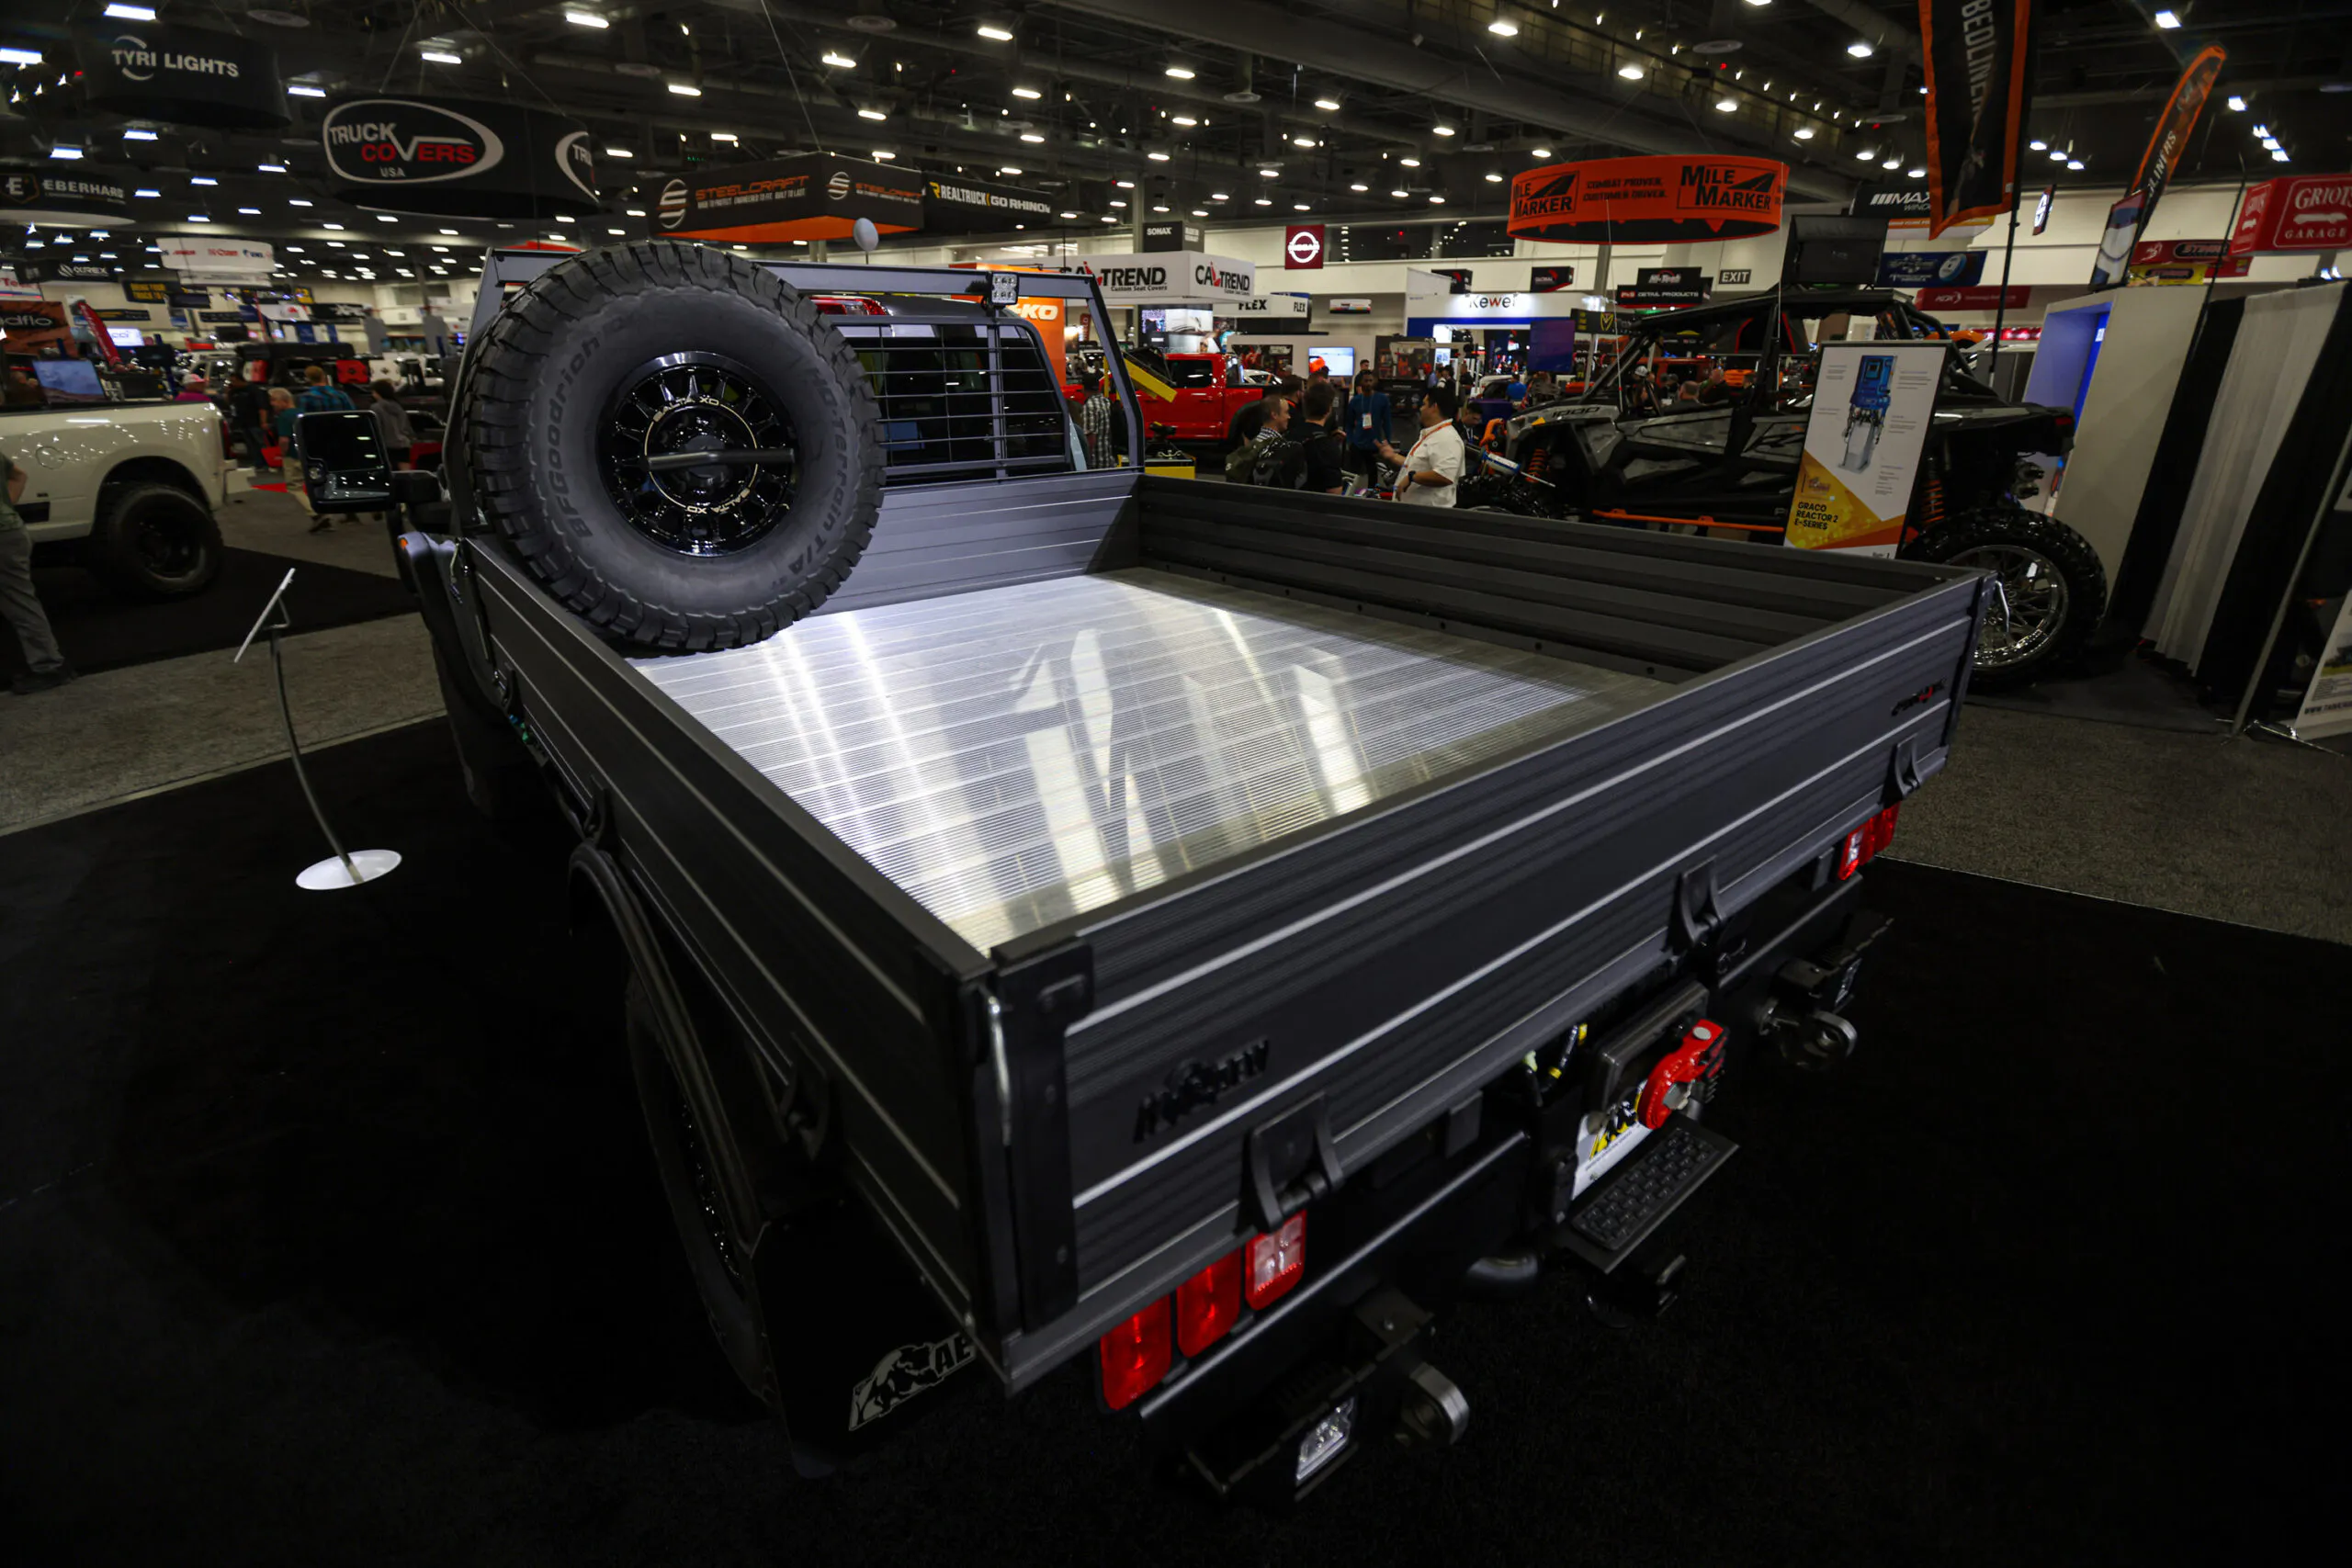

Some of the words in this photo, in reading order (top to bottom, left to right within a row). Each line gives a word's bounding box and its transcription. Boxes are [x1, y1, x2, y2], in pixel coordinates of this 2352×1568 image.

[111, 50, 157, 67] TYRI
[164, 52, 240, 78] LIGHTS
[330, 123, 397, 145] TRUCK
[361, 136, 476, 163] COVERS
[380, 167, 406, 177] USA
[1681, 165, 1736, 186] MILE
[695, 175, 809, 200] STEELCRAFT
[941, 185, 987, 207] REALTRUCK
[990, 193, 1008, 207] GO
[1695, 186, 1771, 210] MARKER
[1147, 226, 1171, 235] SONAX
[2285, 228, 2346, 239] GARAGE
[1722, 272, 1749, 283] EXIT
[1238, 299, 1267, 310] FLEX
[1294, 301, 1306, 312] FLEX
[1798, 502, 1826, 512] GRACO
[1796, 511, 1832, 522] REACTOR
